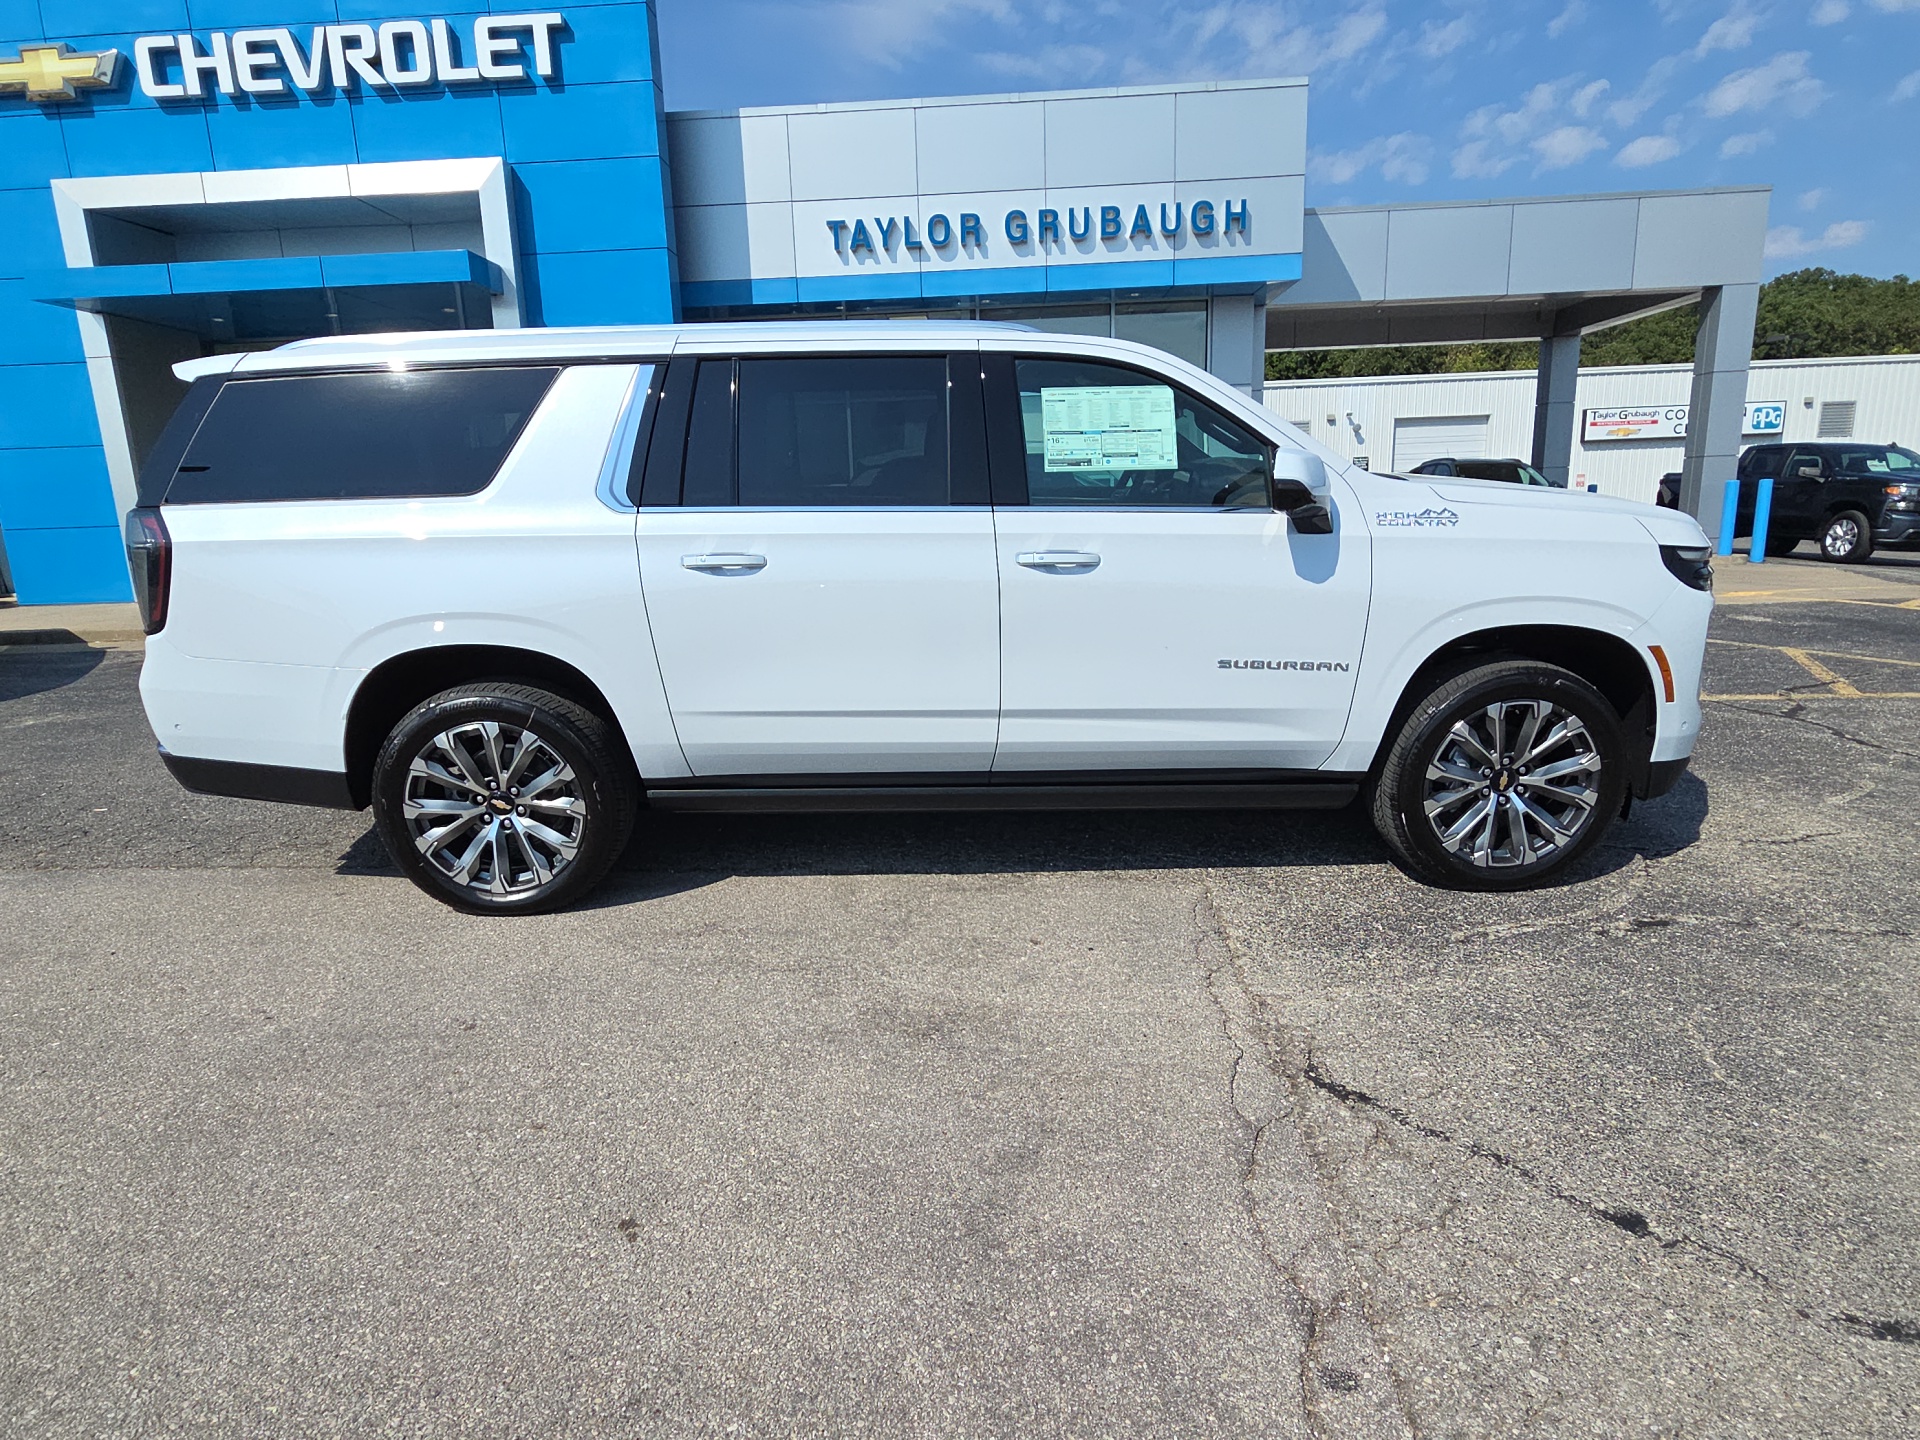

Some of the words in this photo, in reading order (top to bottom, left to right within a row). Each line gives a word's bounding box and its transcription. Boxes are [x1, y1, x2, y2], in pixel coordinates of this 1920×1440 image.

[134, 12, 563, 98] CHEVROLET
[826, 212, 982, 252] TAYLOR
[1004, 198, 1248, 243] GRUBAUGH
[1591, 411, 1618, 421] Taylor
[1619, 410, 1660, 420] Grubaugh
[1753, 408, 1781, 428] PPG
[1375, 511, 1418, 520] HIGH
[1217, 659, 1349, 672] SUBURBAN
